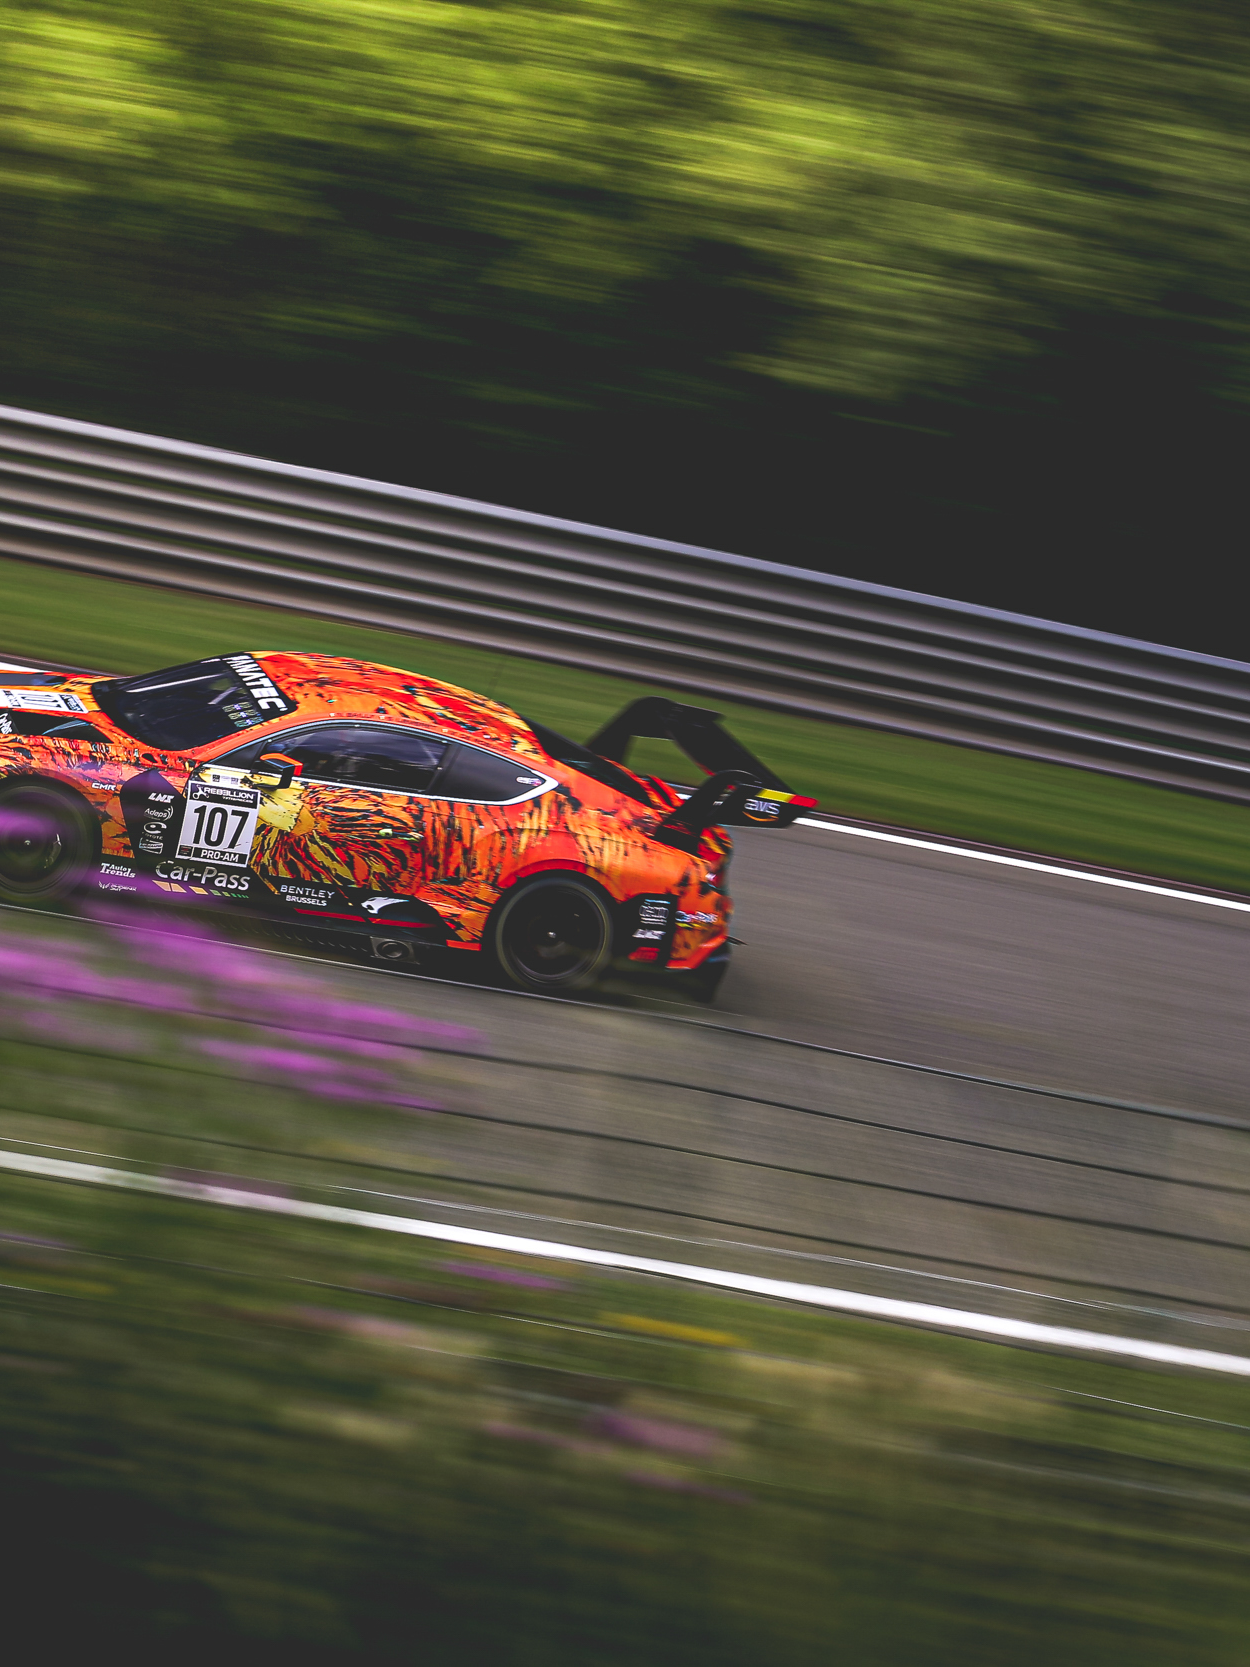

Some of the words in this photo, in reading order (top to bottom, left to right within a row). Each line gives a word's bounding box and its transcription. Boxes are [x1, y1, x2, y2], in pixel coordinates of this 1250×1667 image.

[222, 655, 288, 711] FANATEC
[204, 787, 254, 800] REBELLION
[144, 808, 168, 818] Adeps
[192, 804, 250, 850] 107
[200, 849, 240, 862] PRO-AM
[100, 862, 136, 878] Trends
[109, 864, 128, 872] Auto
[155, 860, 250, 891] Car-Pass
[280, 885, 335, 899] BENTLEY
[286, 895, 327, 907] BRUSSELS
